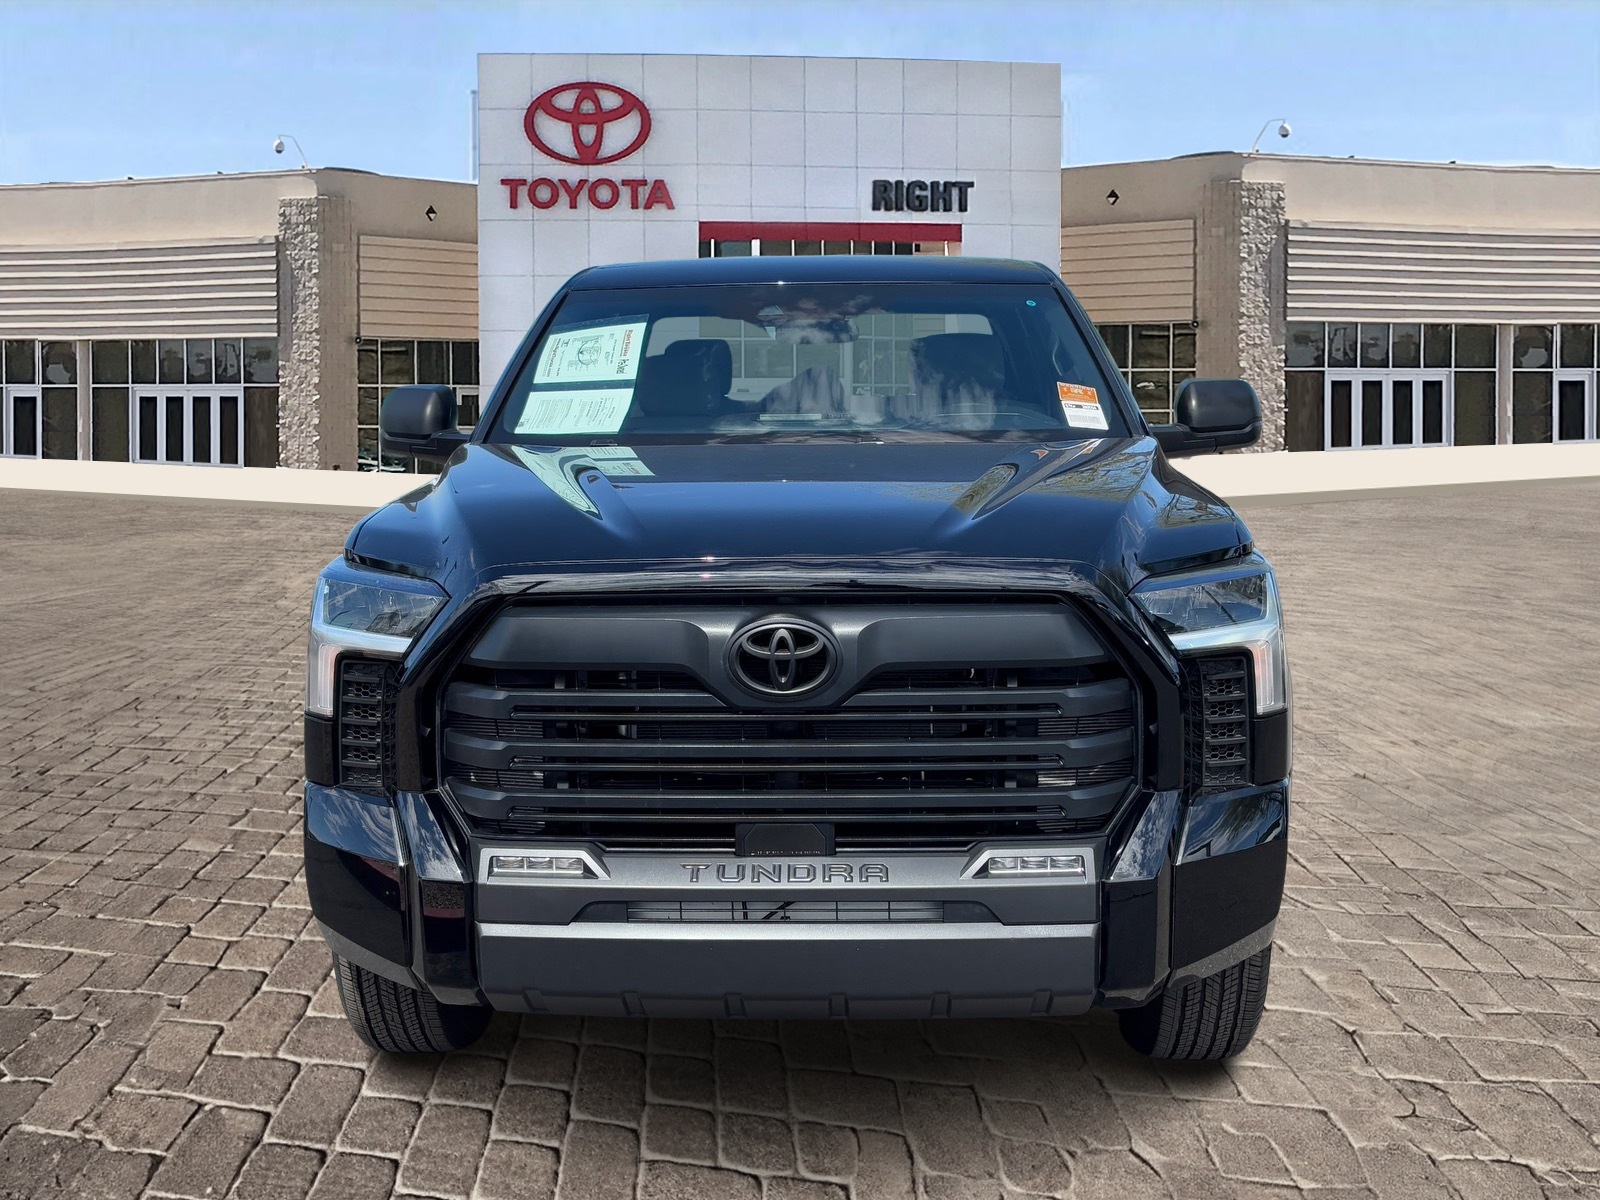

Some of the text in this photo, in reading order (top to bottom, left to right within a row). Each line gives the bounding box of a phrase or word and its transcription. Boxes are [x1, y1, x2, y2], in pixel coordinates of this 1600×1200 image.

[500, 177, 675, 210] TOYOTA
[872, 179, 975, 212] RIGHT
[680, 862, 890, 883] TUNDRA
